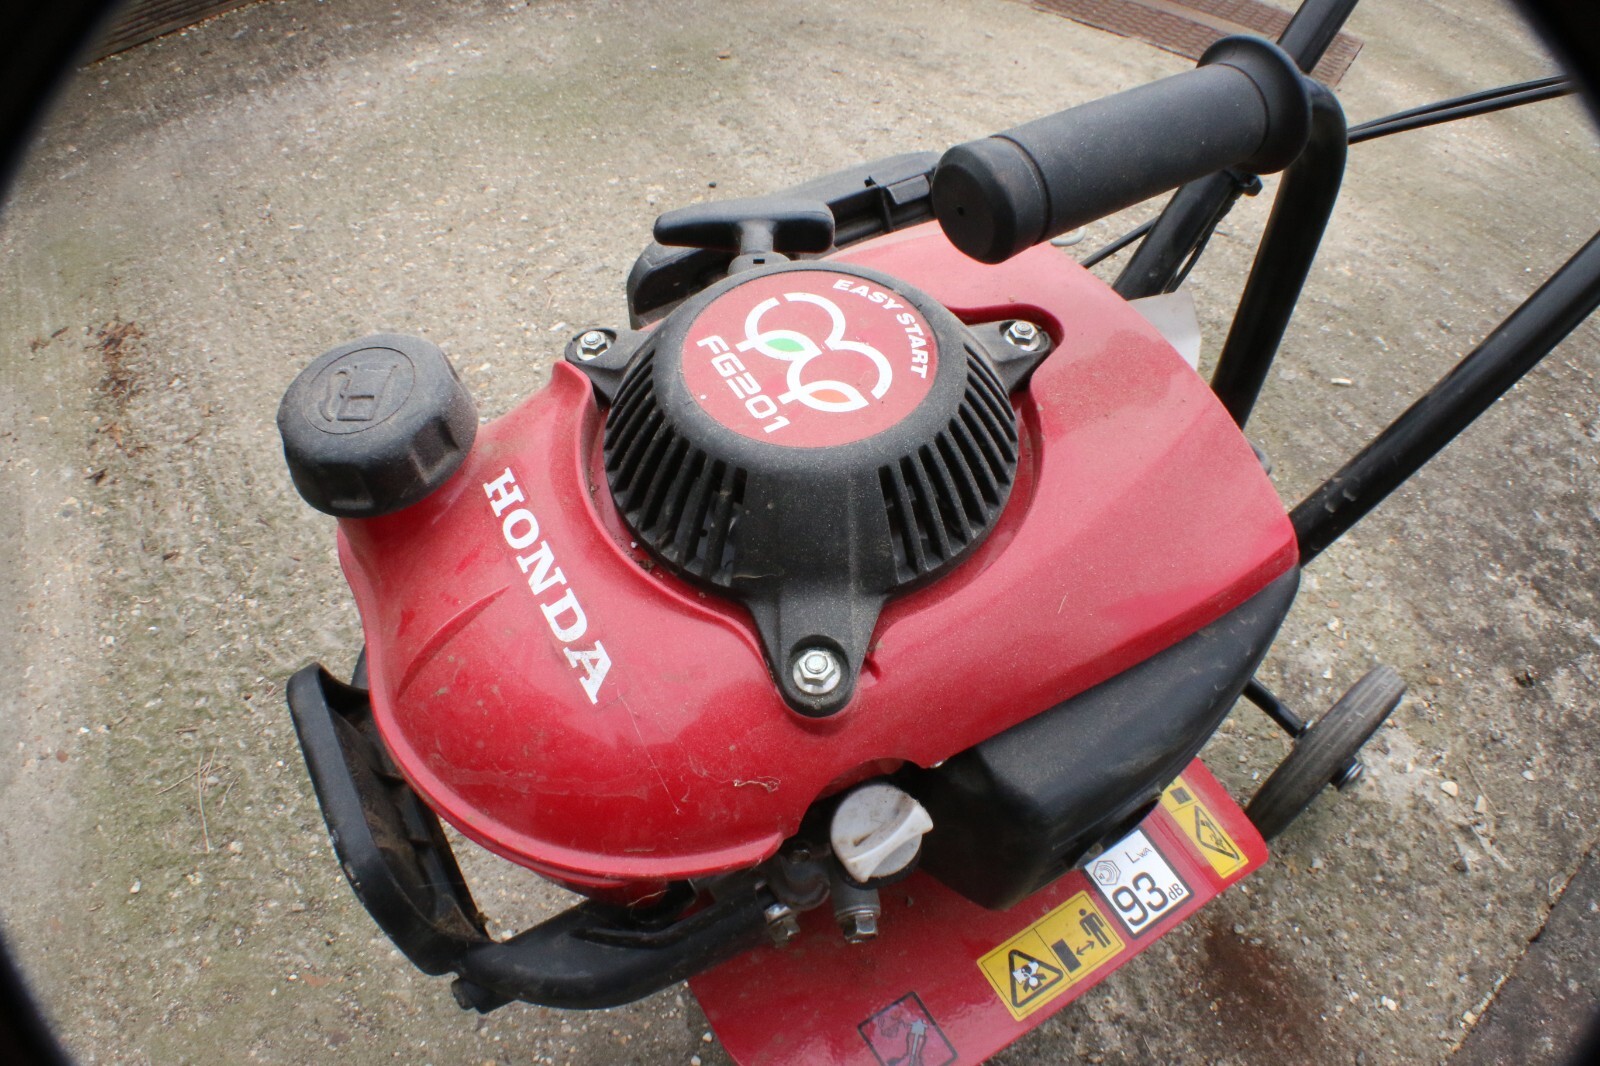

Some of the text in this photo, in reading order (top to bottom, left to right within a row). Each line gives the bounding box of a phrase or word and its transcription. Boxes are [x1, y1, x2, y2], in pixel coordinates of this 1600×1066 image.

[832, 279, 929, 379] EASY START
[696, 335, 791, 433] FG201
[482, 466, 612, 705] HONDA
[1111, 871, 1184, 927] 93 dB
